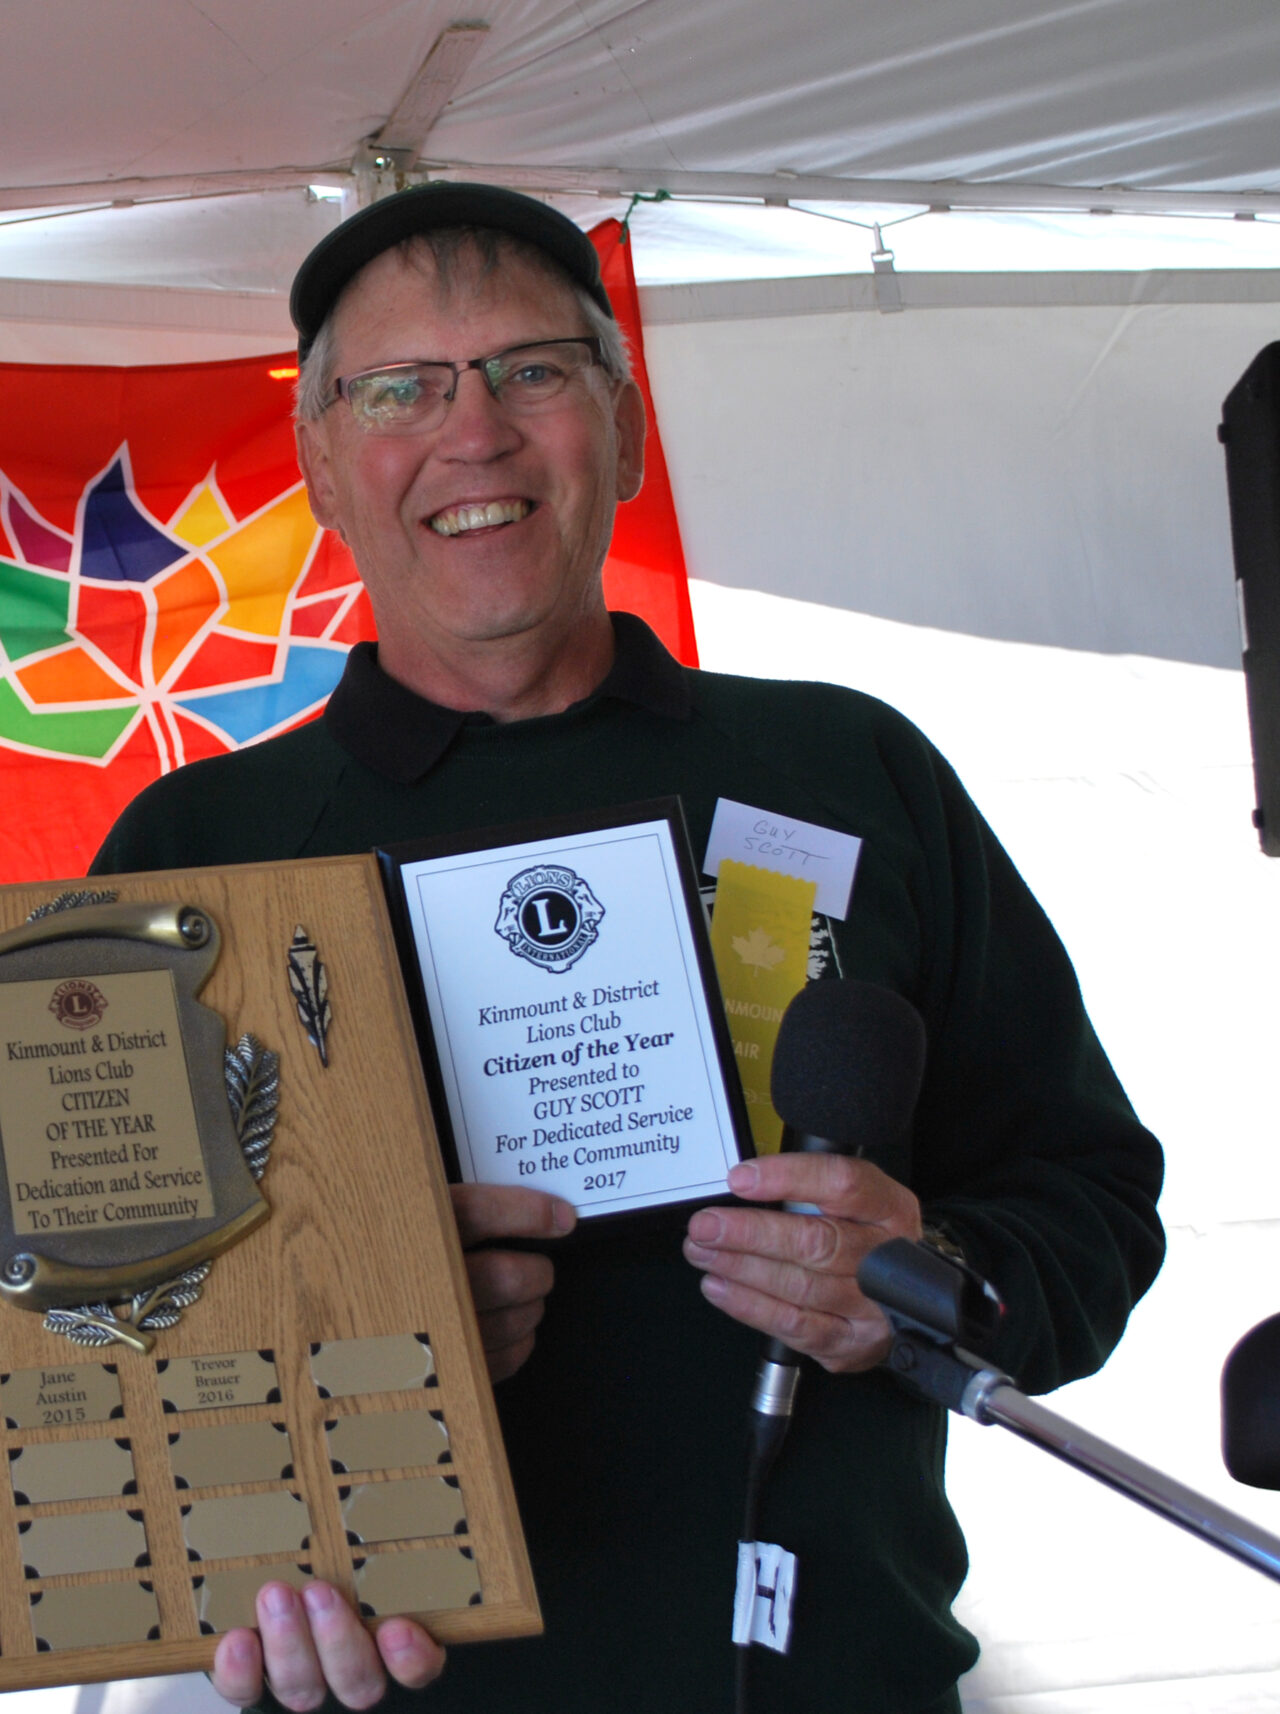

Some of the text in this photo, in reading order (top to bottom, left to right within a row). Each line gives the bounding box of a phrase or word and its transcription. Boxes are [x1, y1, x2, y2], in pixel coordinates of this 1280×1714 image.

[743, 836, 830, 866] SCOTT
[513, 871, 571, 895] LIONS
[531, 898, 568, 937] L
[520, 933, 588, 961] INTERNATIONAL
[71, 995, 88, 1013] L
[478, 980, 660, 1026] Kinmount & District
[723, 997, 784, 1024] NMOUN
[526, 1011, 621, 1044] Lions Club
[6, 1030, 167, 1061] Kinmount & District
[483, 1031, 675, 1077] Citizen of the Year
[731, 1039, 759, 1060] AIR
[48, 1059, 134, 1085] Lions Club
[528, 1062, 640, 1095] Presented to
[61, 1088, 130, 1112] CITIZEN
[533, 1085, 645, 1120] GUY SCOTT
[46, 1113, 156, 1141] OF THE YEAR
[495, 1104, 694, 1154] For Dedicated Service
[51, 1143, 158, 1170] Presented For
[518, 1133, 680, 1175] to the Community
[16, 1166, 203, 1201] Dedication and Service
[583, 1170, 626, 1190] 2017
[28, 1195, 199, 1229] To Their Community
[191, 1358, 237, 1371] Trevor
[40, 1371, 76, 1389] Jane
[195, 1375, 241, 1387] Brauer
[36, 1387, 87, 1405] Austin
[198, 1389, 234, 1404] 2016
[42, 1407, 86, 1424] 2015
